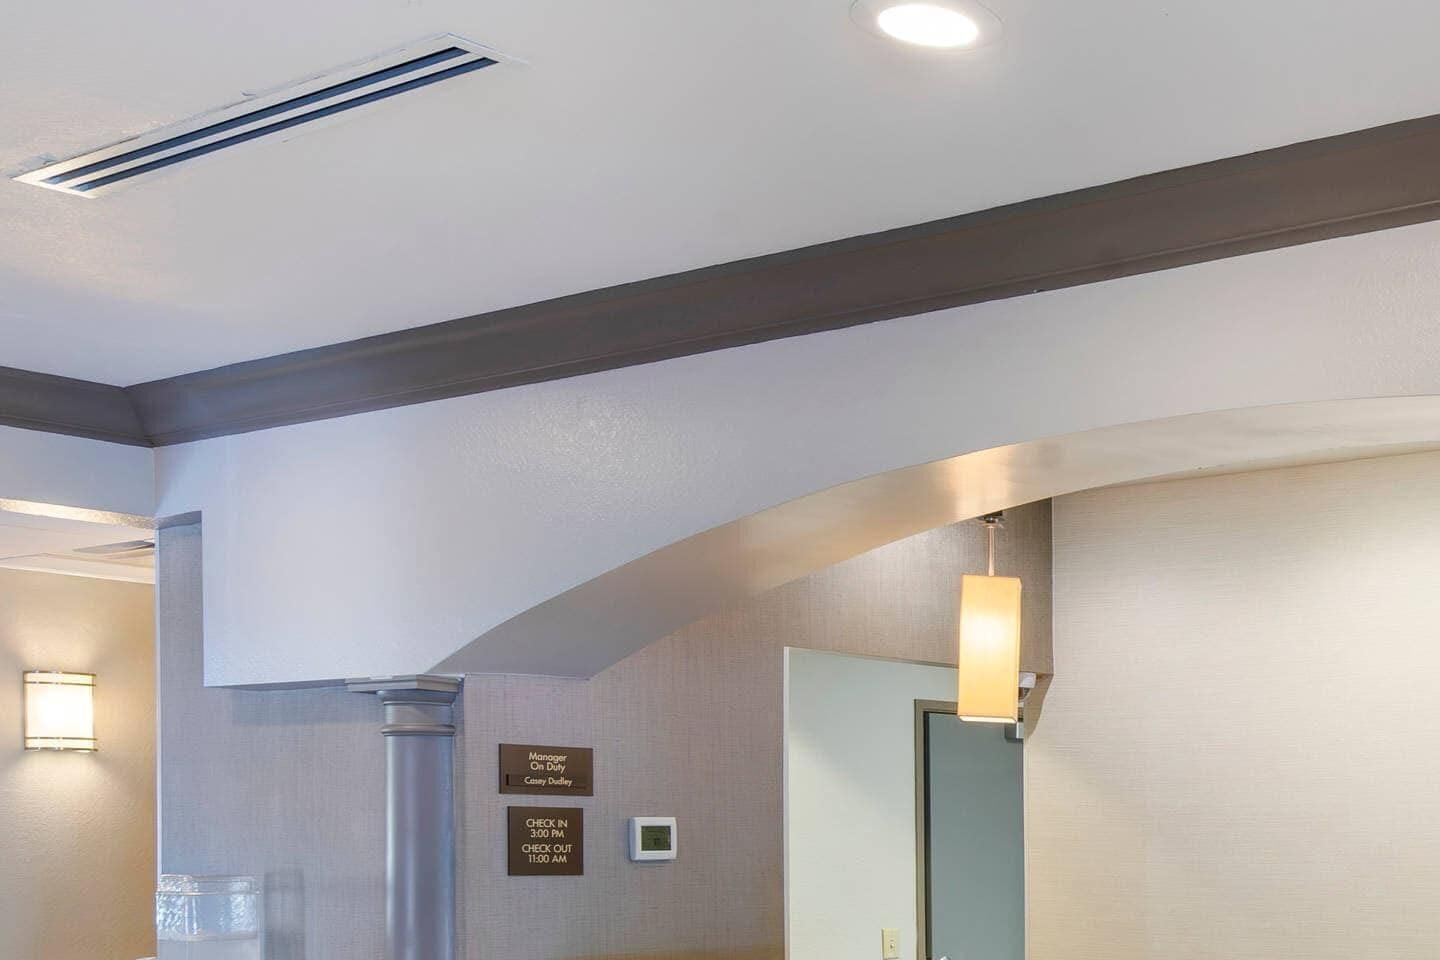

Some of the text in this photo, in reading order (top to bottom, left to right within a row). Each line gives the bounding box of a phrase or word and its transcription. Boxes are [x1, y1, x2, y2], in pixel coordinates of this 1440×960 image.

[529, 752, 567, 763] Manager
[531, 762, 565, 773] On Duty
[524, 777, 572, 787] Casey Dudley
[526, 819, 567, 828] CHECK IN
[530, 829, 564, 838] 3:00 PM
[521, 844, 572, 853] CHECK OUT
[528, 855, 567, 863] 11:00 AM
